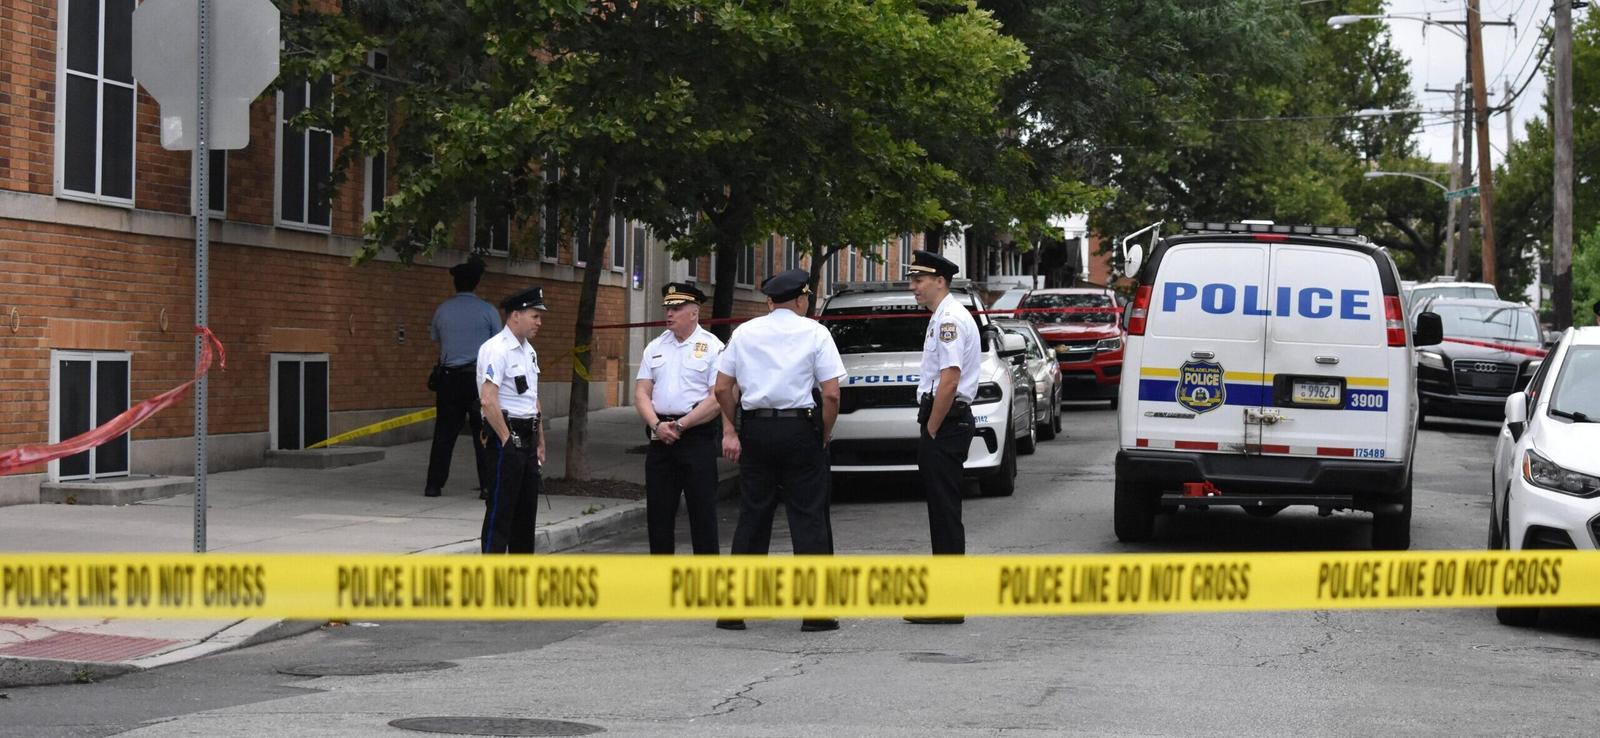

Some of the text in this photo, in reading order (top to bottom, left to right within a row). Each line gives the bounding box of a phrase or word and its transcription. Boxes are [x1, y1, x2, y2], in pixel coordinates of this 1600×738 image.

[871, 304, 926, 312] POLICE
[1162, 282, 1371, 320] POLICE
[848, 374, 920, 385] POLIC
[1185, 373, 1219, 386] POLICE
[1351, 394, 1383, 408] 3900
[1355, 448, 1385, 458] 175489
[2, 565, 266, 607] POLICE LINE DO NOT CROSS
[338, 566, 599, 608] POLICE LINE DO NOT CROSS
[671, 567, 928, 607] POLICE LINE DO NOT CROSS
[998, 563, 1251, 605] POLICE LINE DO NOT CROSS
[1317, 558, 1562, 599] POLICE LINE DO NOT CROSS
